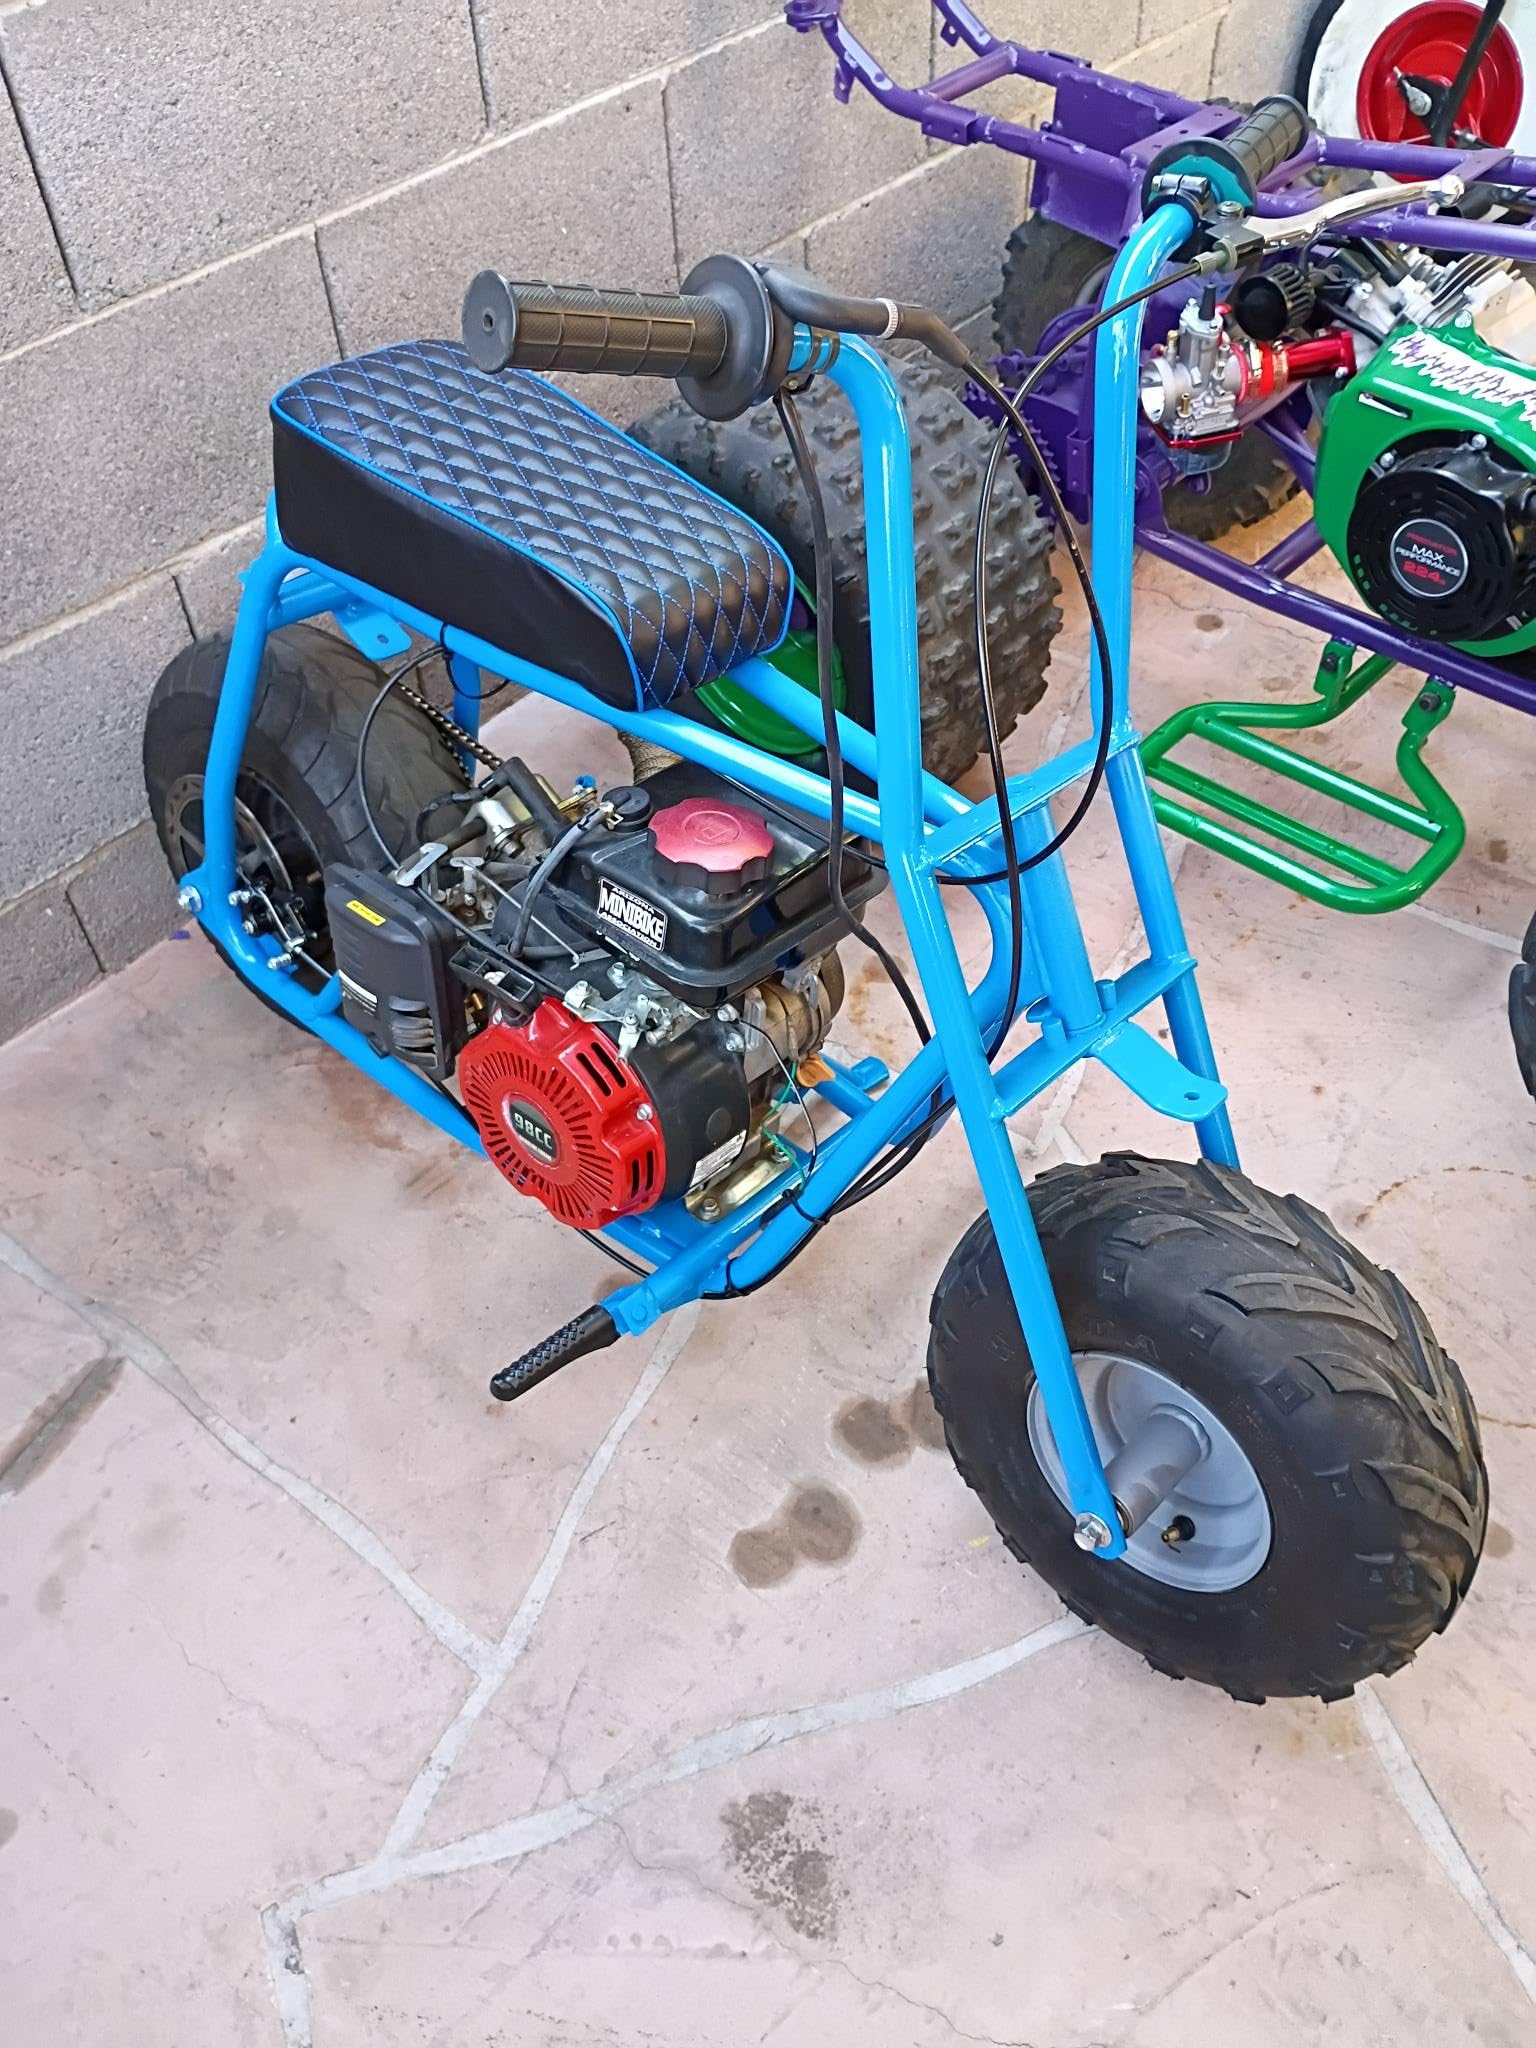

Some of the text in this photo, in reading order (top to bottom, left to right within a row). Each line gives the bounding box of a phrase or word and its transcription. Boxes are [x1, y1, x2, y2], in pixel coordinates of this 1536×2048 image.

[1395, 546, 1461, 577] PERFORMANCE
[1411, 543, 1445, 563] MAX
[600, 887, 665, 944] MINIBIKE
[611, 886, 655, 915] ARIZONA
[601, 911, 658, 948] ASSOCIATION
